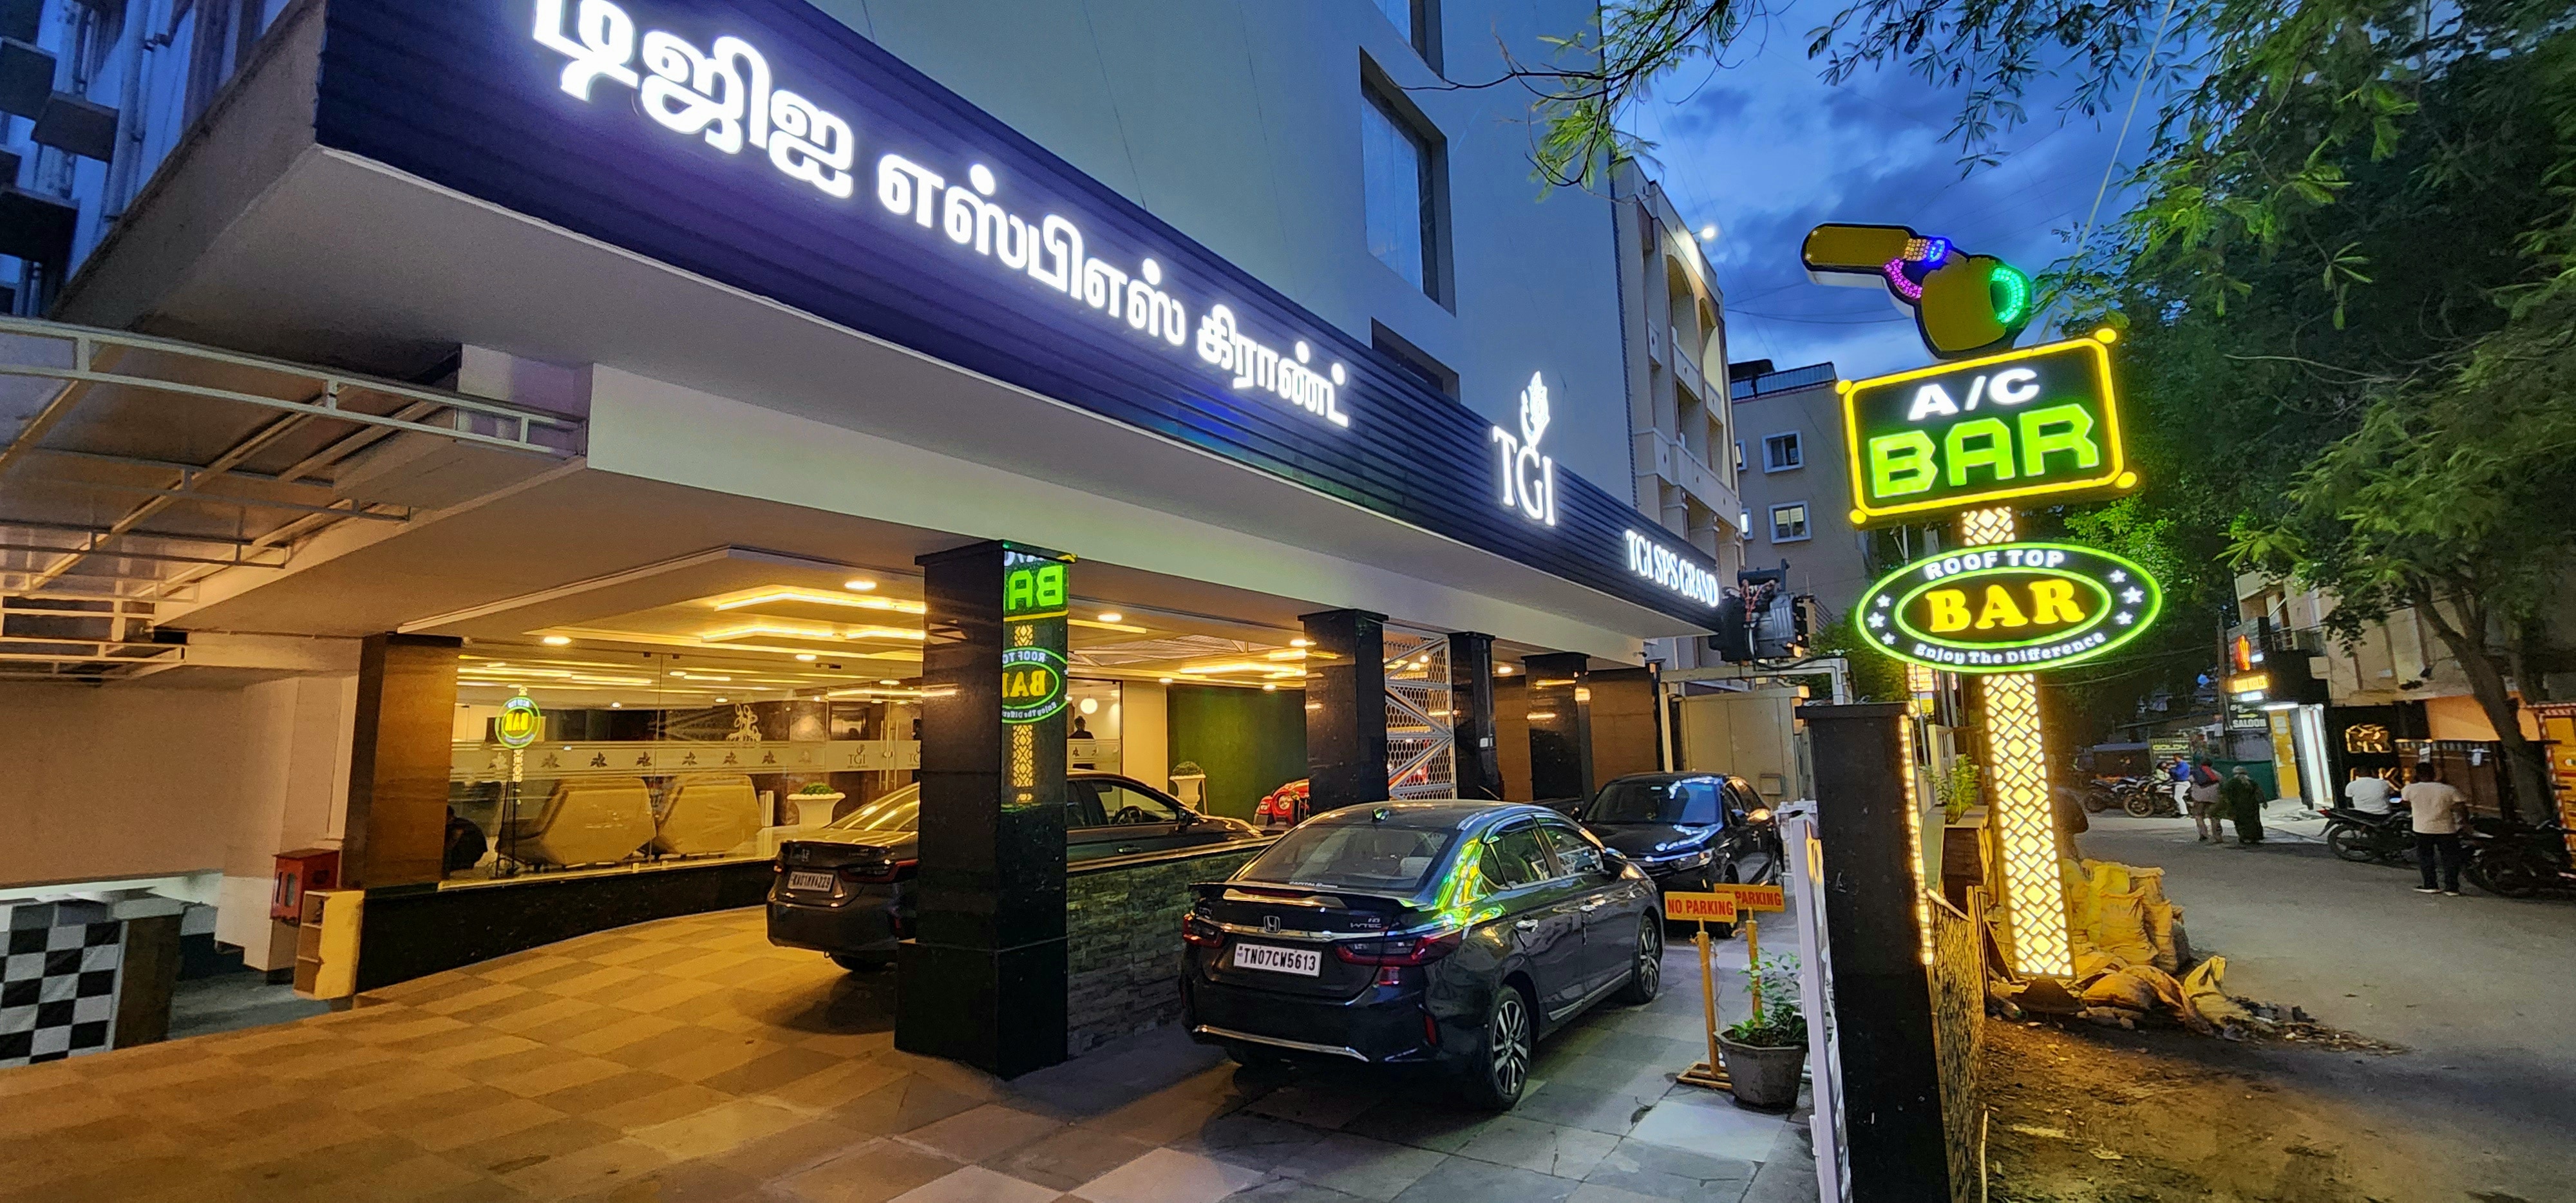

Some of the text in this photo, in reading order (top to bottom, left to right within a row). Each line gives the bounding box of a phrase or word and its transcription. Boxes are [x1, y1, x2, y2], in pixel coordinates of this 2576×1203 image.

[878, 154, 1186, 345] எஸ்பிஎஸ்
[1197, 304, 1349, 428] கிராண்ட்
[1870, 403, 2099, 498] BAR
[1492, 425, 1556, 527] TGI
[1625, 529, 1719, 607] TGI SPS GRAND
[1923, 549, 2065, 580] ROOF TOP
[1926, 579, 2085, 632] BAR
[1914, 632, 2106, 665] Enjoy The Difference
[1667, 899, 1734, 916] NO PARKING
[1735, 891, 1782, 906] PARKING
[1244, 947, 1316, 972] TN07CW5613
